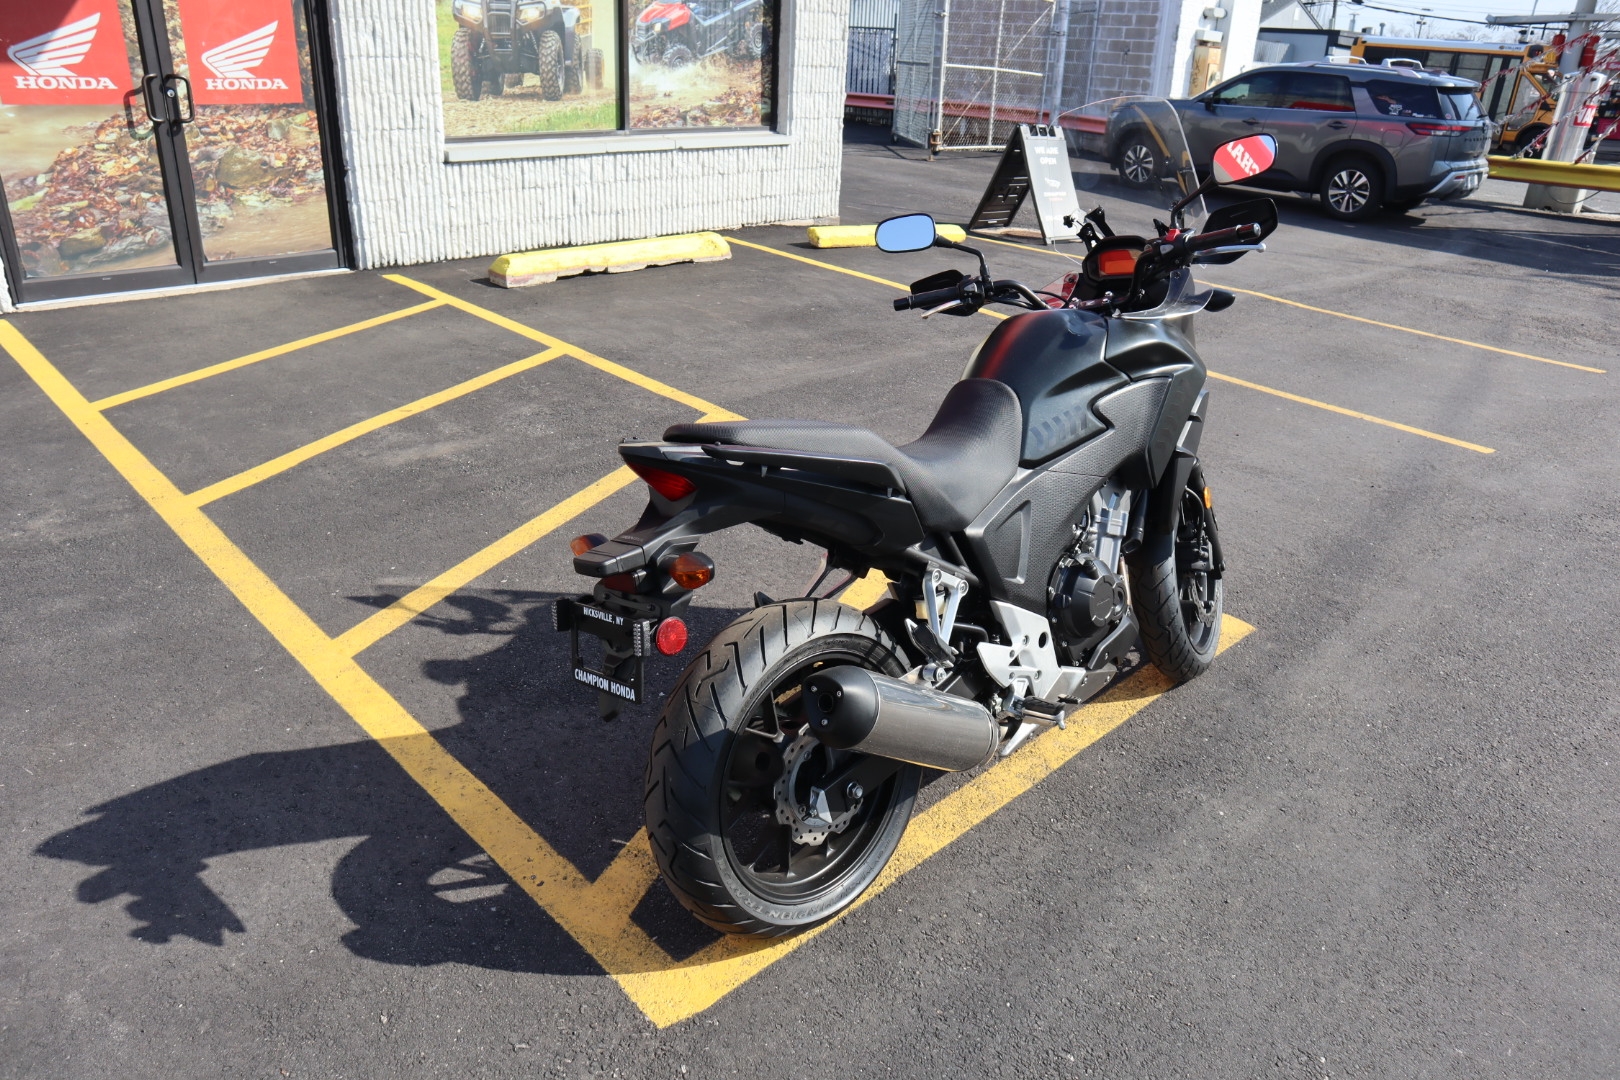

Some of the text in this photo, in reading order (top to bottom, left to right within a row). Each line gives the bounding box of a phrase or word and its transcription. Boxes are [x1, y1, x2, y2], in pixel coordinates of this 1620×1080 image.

[13, 75, 118, 90] HONDA
[205, 78, 289, 90] HONDA
[1034, 146, 1046, 155] WE
[1039, 157, 1057, 165] OPEN
[615, 616, 624, 626] NY
[574, 668, 636, 702] CHAMPION HONDA
